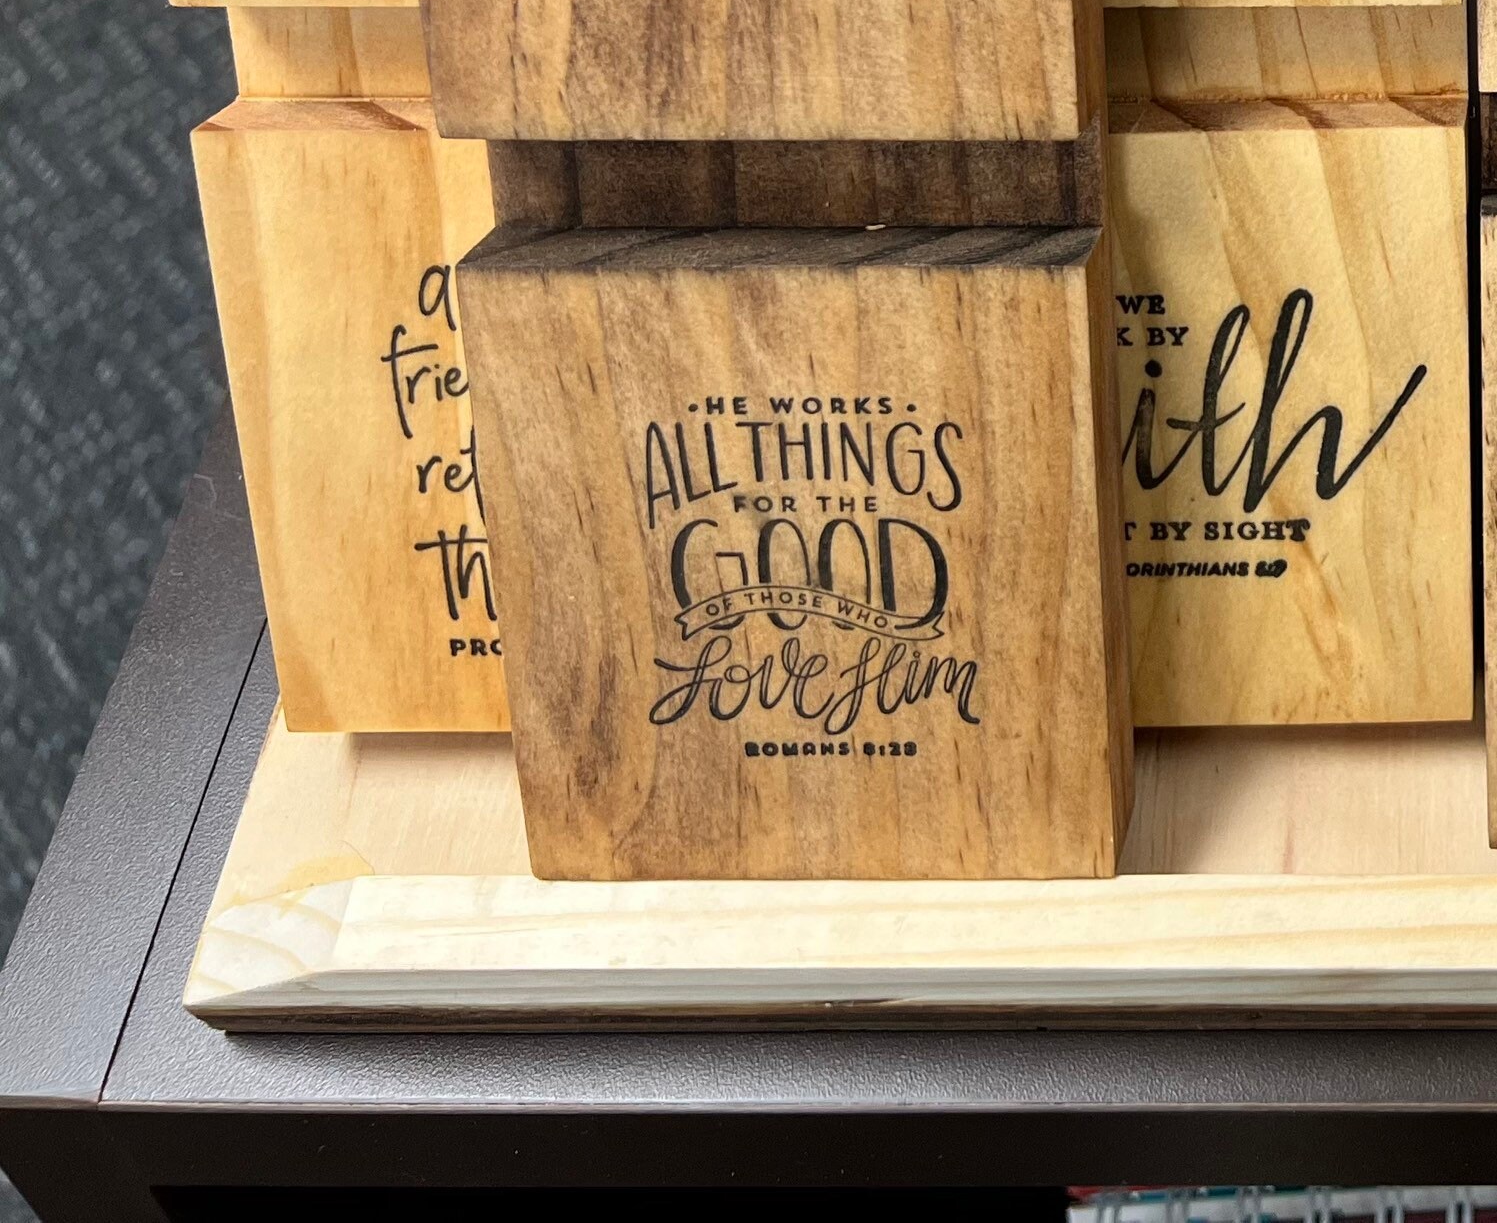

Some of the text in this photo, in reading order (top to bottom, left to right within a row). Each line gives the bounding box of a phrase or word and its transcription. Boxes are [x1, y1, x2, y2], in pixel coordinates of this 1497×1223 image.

[418, 264, 458, 332] a
[1115, 294, 1166, 315] WE
[1147, 327, 1190, 347] BY
[706, 395, 894, 416] HE WORKS
[733, 494, 879, 514] FOR THE
[1150, 521, 1192, 542] BY
[1203, 518, 1312, 543] SIGHT
[670, 517, 950, 633] GOOD
[704, 589, 890, 631] OF THOSE WHO
[649, 636, 838, 726] Love
[744, 741, 850, 757] ROMANS
